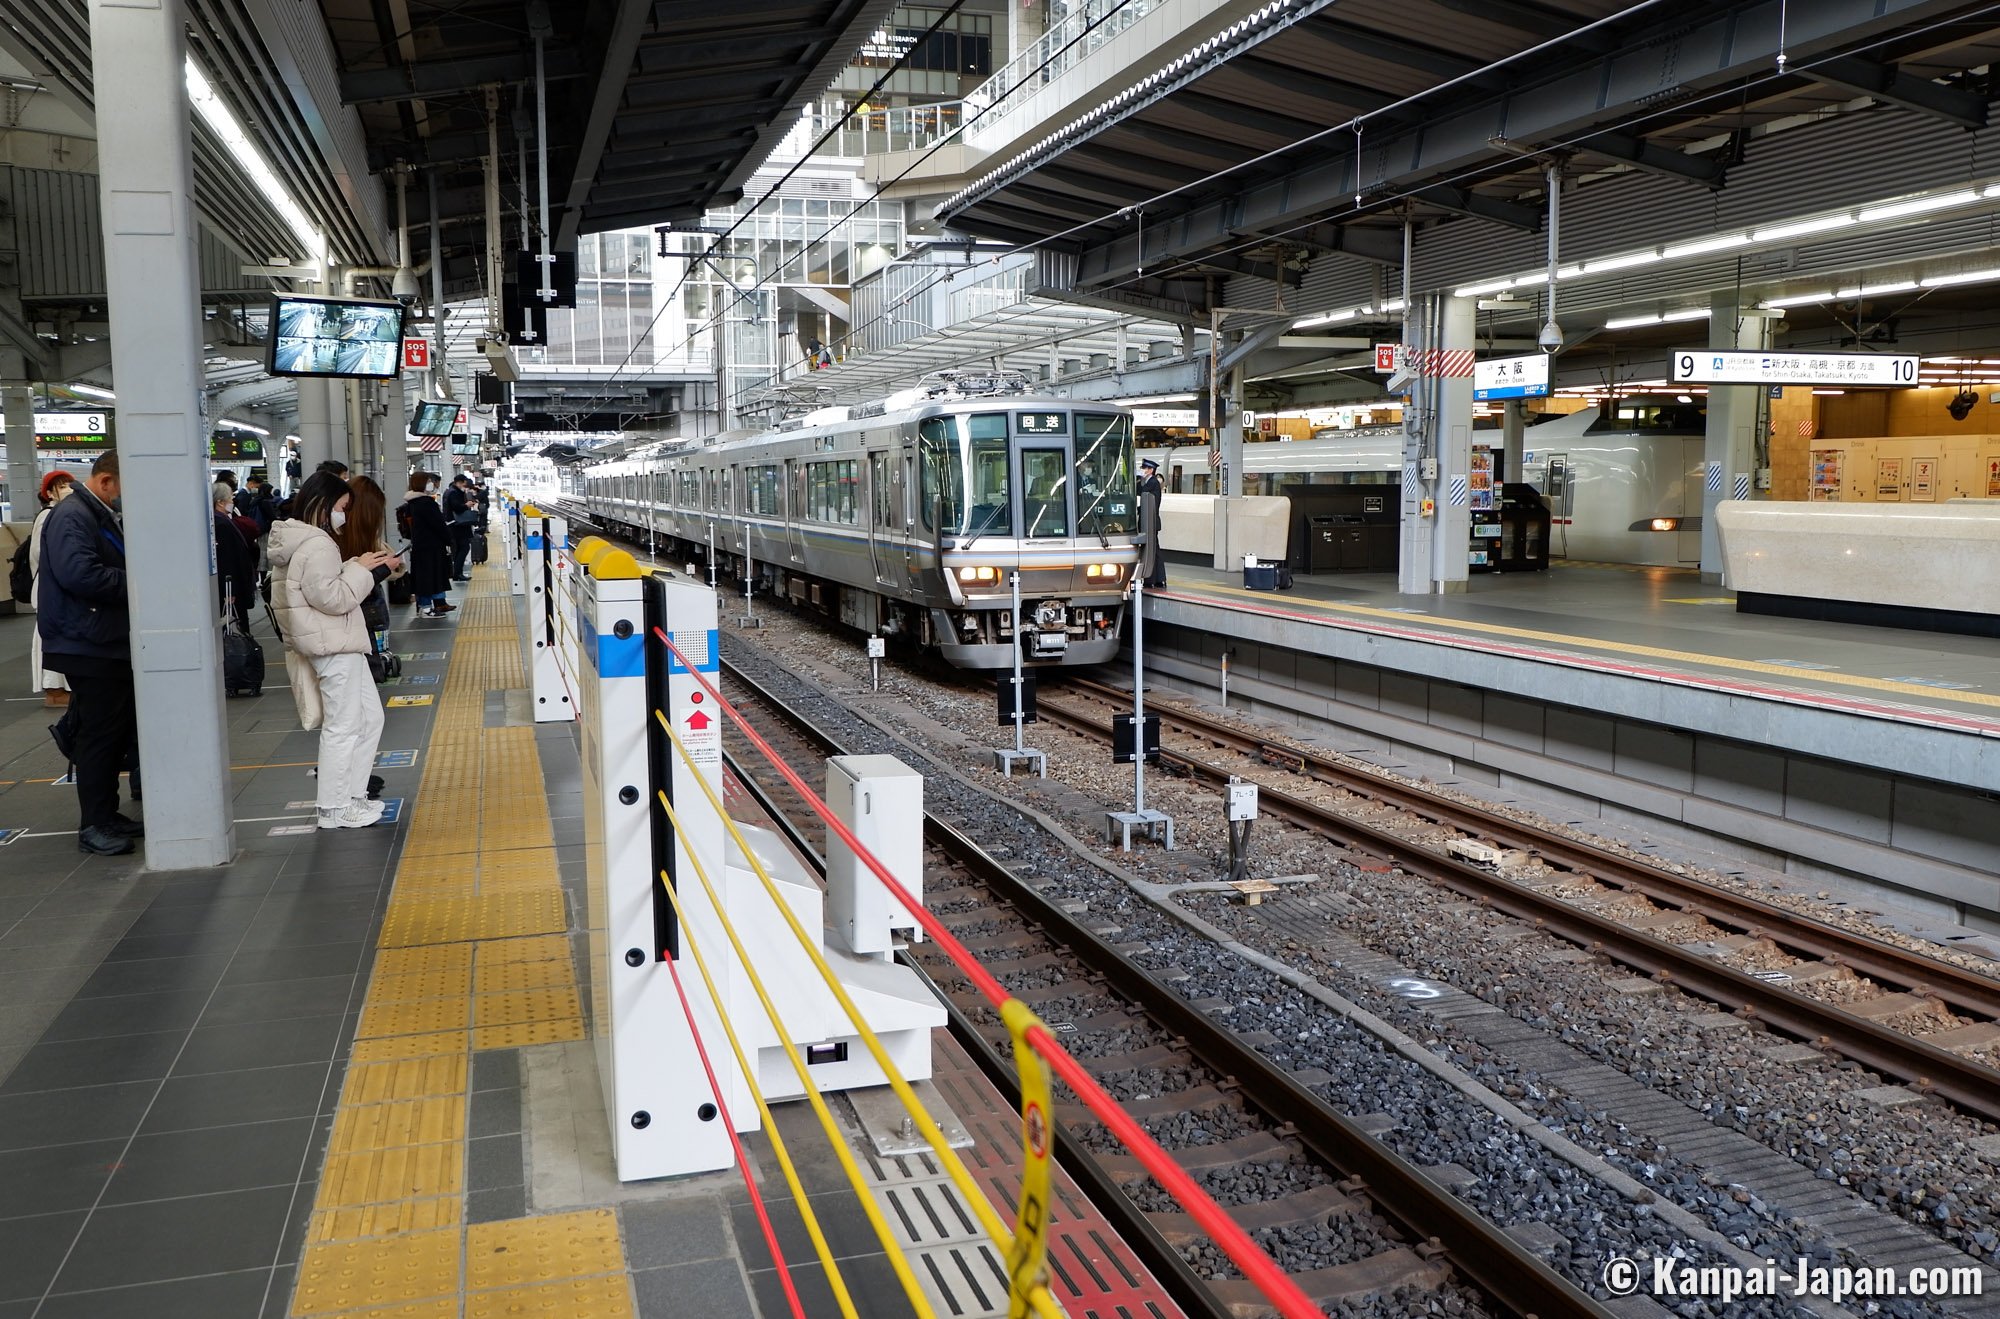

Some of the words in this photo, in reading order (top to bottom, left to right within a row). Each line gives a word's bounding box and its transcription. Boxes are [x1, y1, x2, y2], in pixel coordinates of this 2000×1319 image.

[1498, 362, 1522, 376] 大阪
[1680, 356, 1694, 378] 9
[1714, 358, 1723, 370] A
[1772, 358, 1856, 370] 新大阪・高槻・京都
[1860, 362, 1875, 370] 方面
[1892, 360, 1914, 382] 10
[88, 416, 100, 431] 8
[1022, 416, 1058, 428] 回送
[893, 470, 900, 484] JR
[1111, 504, 1126, 512] JR
[1391, 980, 1440, 998] 3
